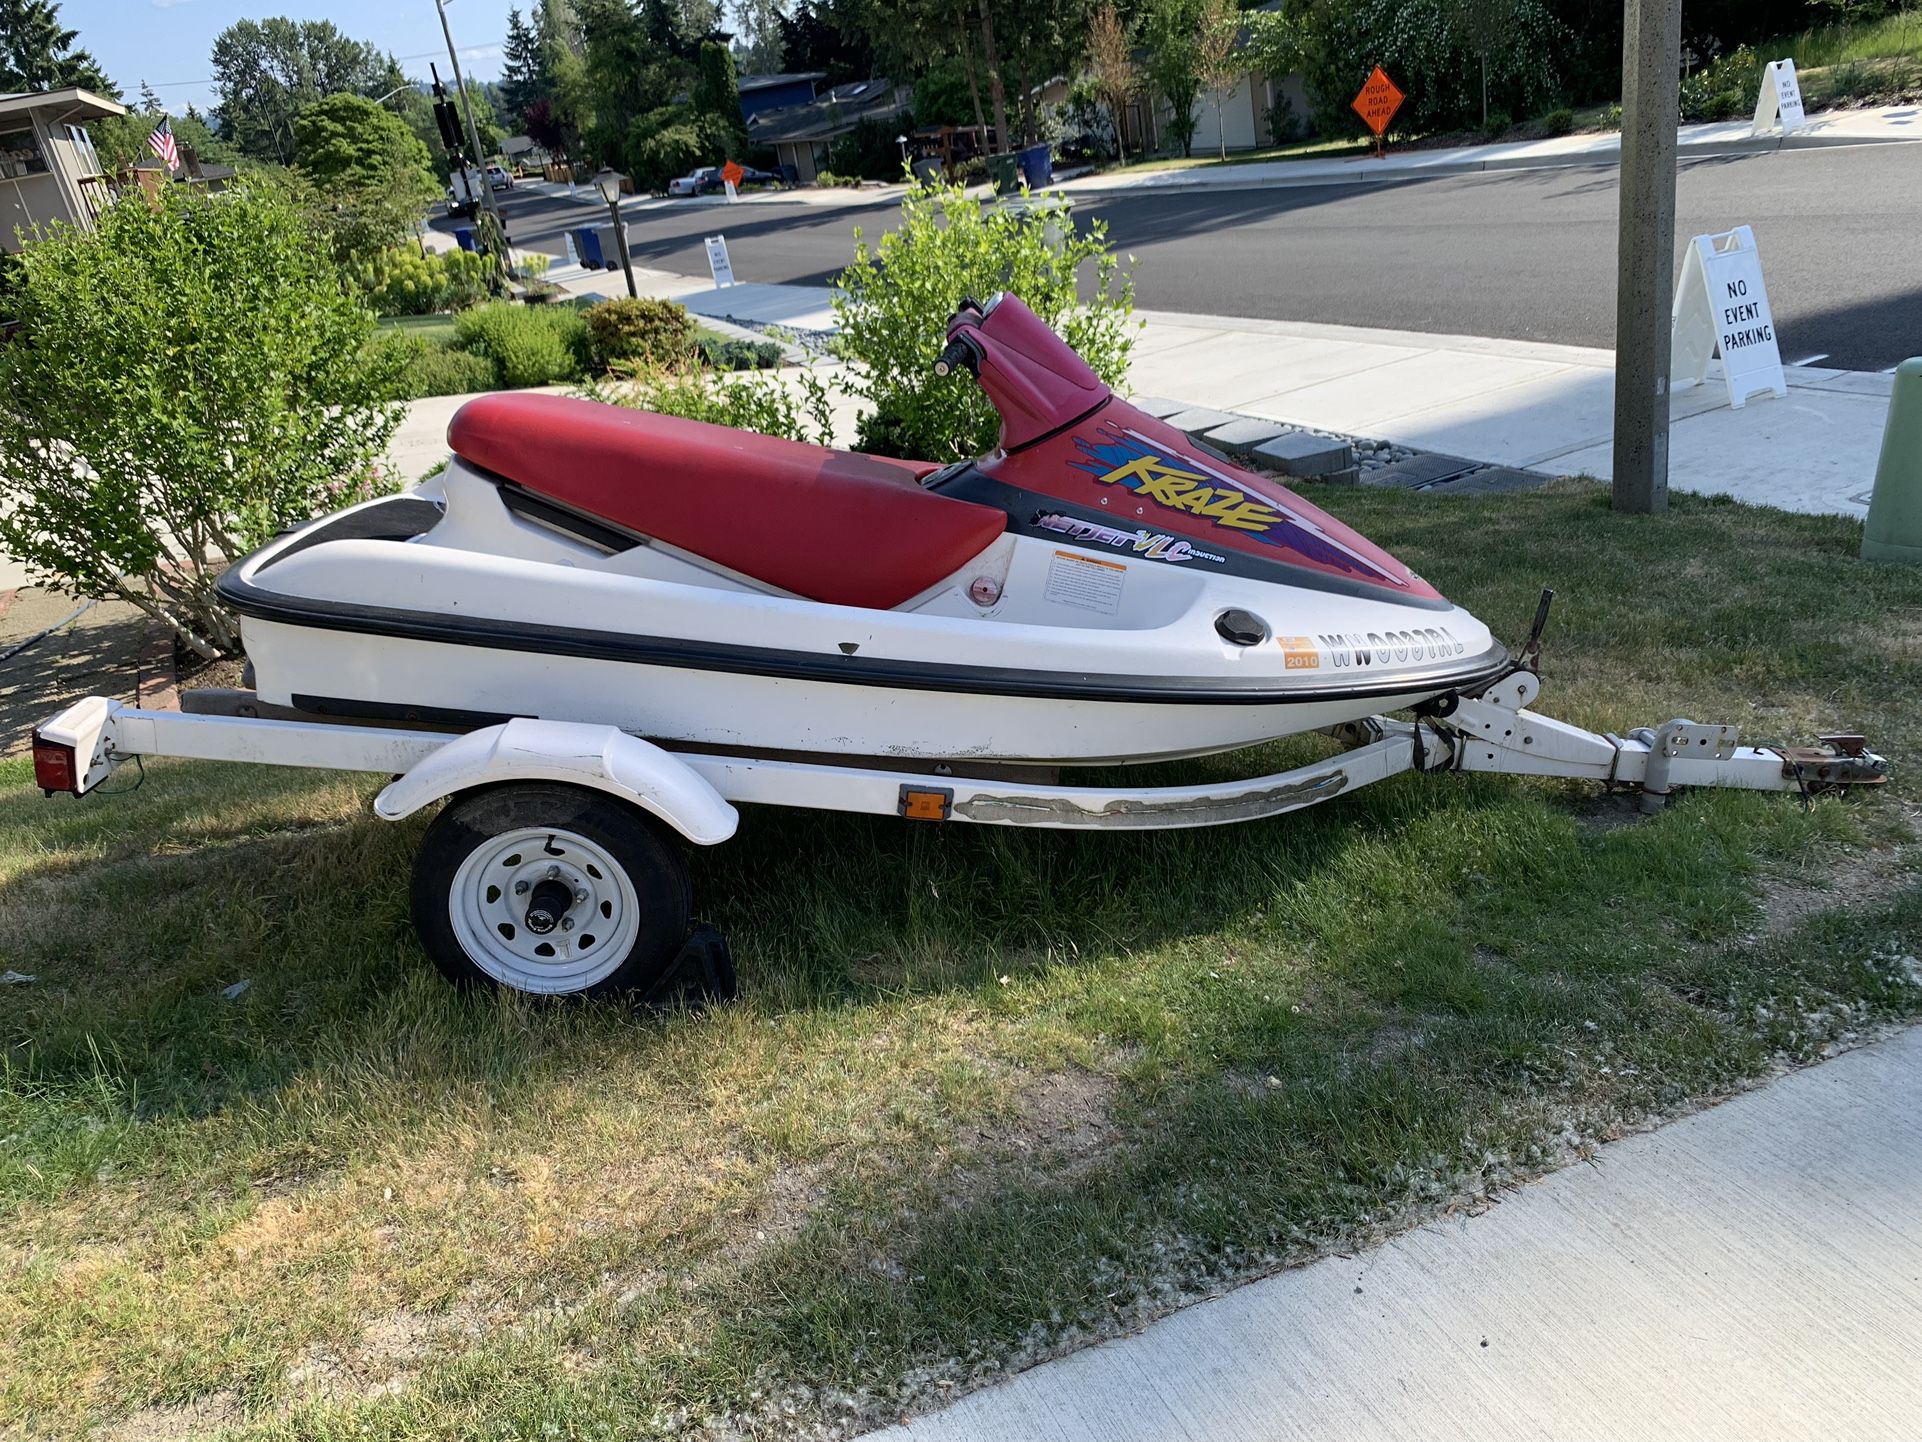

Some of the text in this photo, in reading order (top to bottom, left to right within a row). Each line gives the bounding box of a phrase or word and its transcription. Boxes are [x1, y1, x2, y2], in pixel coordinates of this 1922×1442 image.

[1365, 84, 1390, 95] ROUGH
[1368, 96, 1388, 106] ROAD
[1366, 107, 1391, 118] AHEAD
[1727, 279, 1747, 299] NO
[1725, 302, 1760, 325] EVENT
[1724, 325, 1772, 351] PARKING
[1099, 456, 1282, 531] KRAZE
[1286, 656, 1318, 668] 2010
